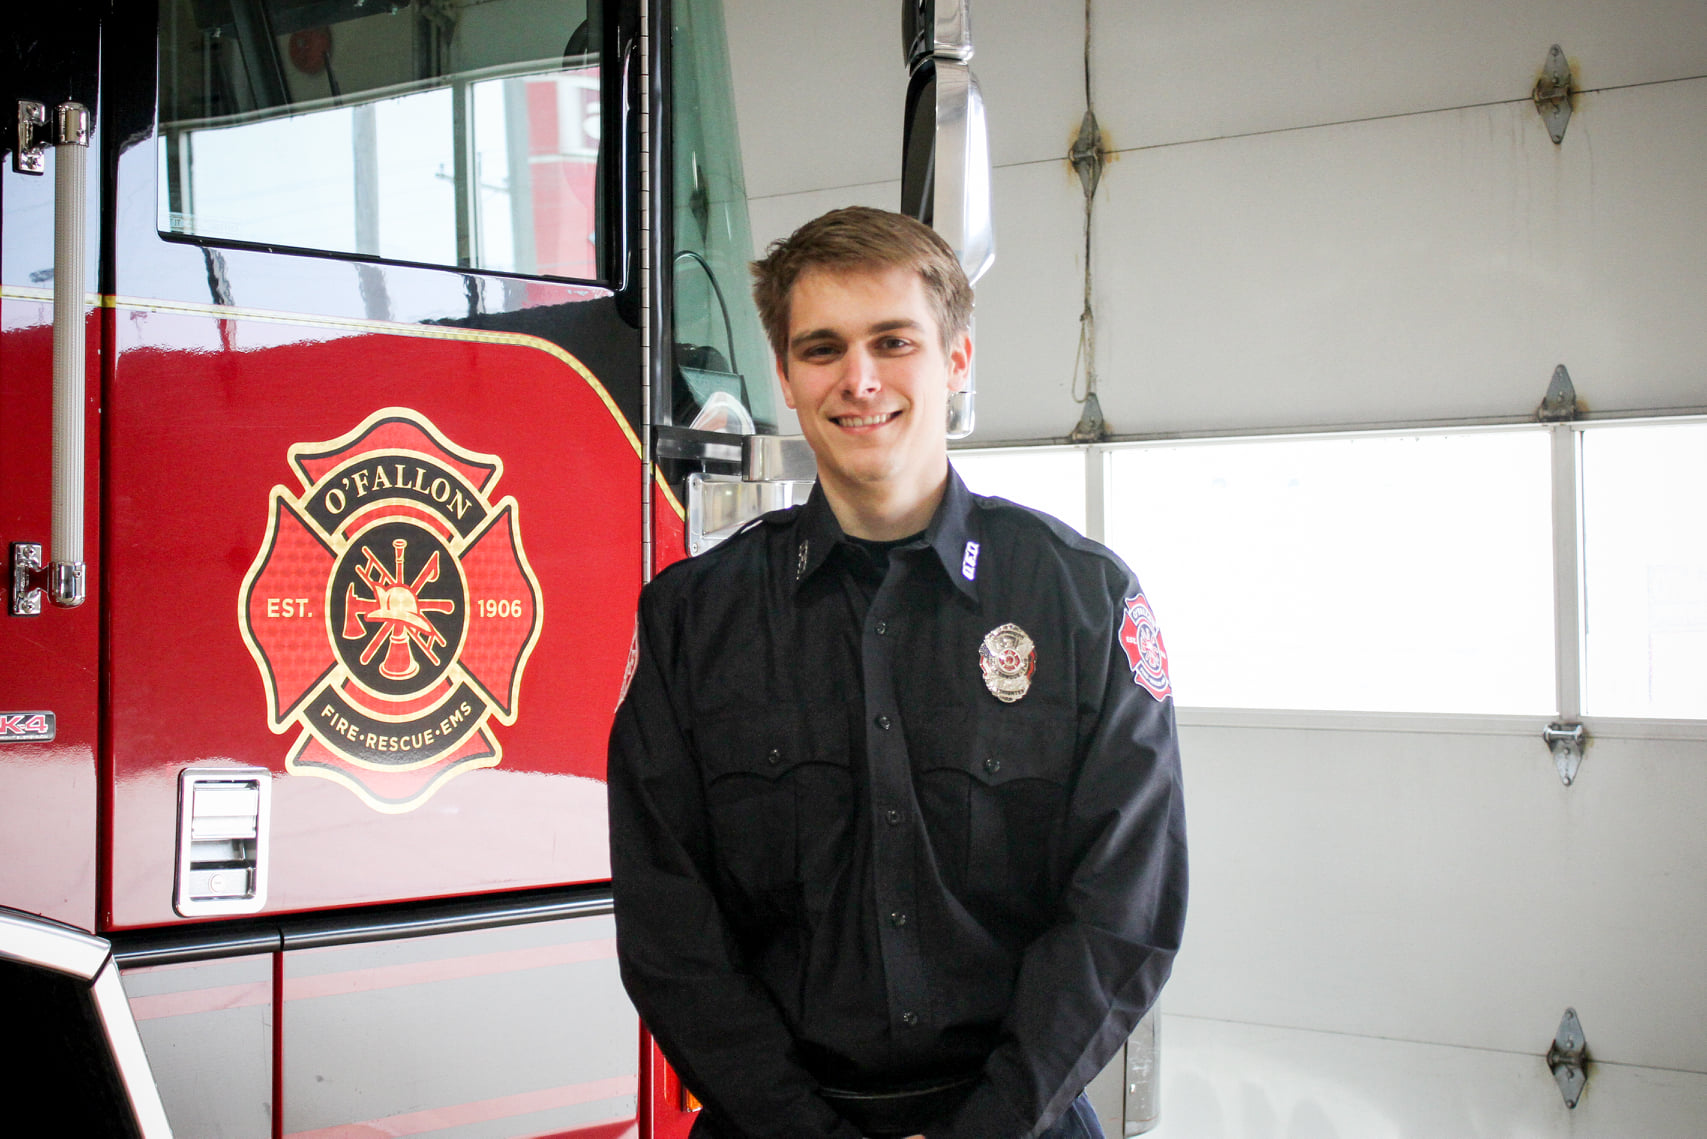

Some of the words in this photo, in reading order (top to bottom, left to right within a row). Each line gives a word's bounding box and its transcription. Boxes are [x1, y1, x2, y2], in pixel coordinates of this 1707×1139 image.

[325, 464, 472, 520] O'FALLON
[267, 598, 313, 618] EST.
[477, 599, 522, 618] 1906
